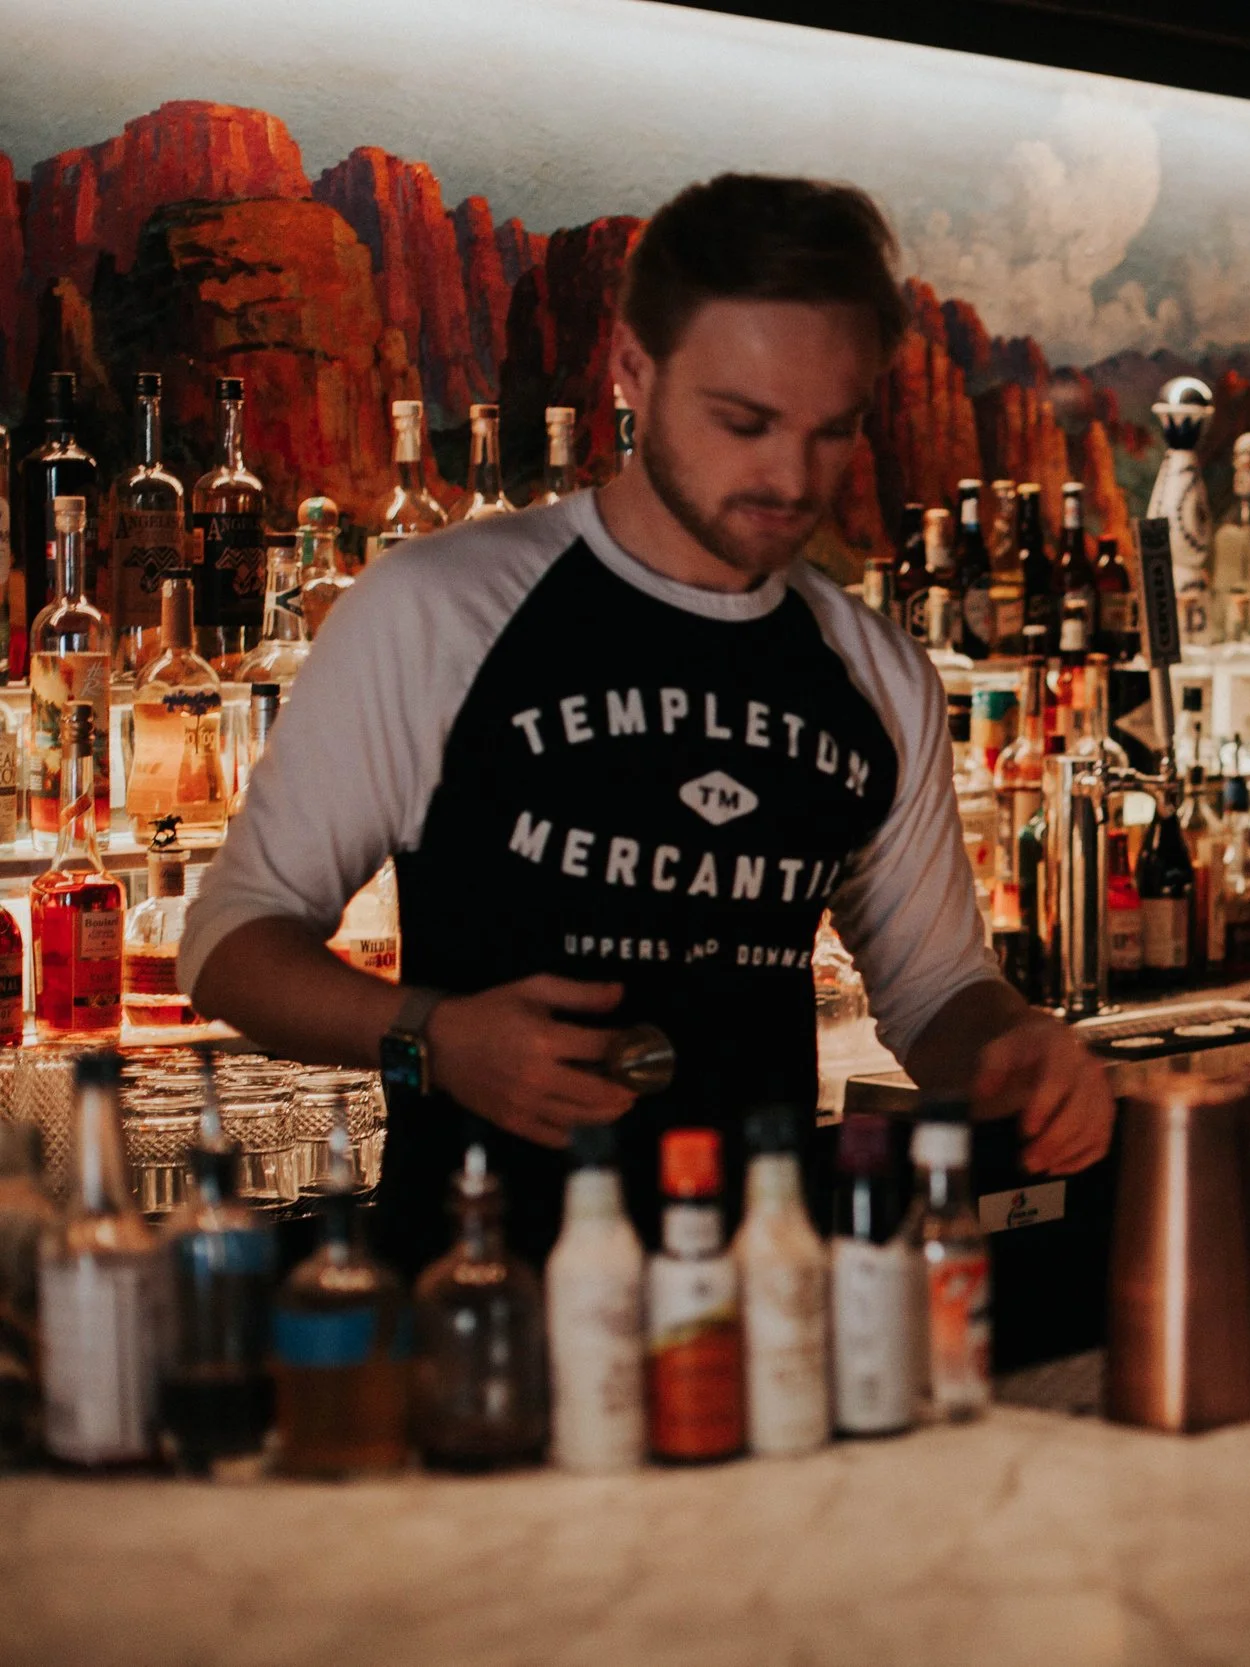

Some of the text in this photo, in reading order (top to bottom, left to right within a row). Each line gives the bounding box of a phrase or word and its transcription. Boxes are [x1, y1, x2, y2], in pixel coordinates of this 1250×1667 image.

[511, 687, 870, 797] TEMPLETON
[697, 784, 741, 812] TM
[564, 935, 671, 962] UPPERS
